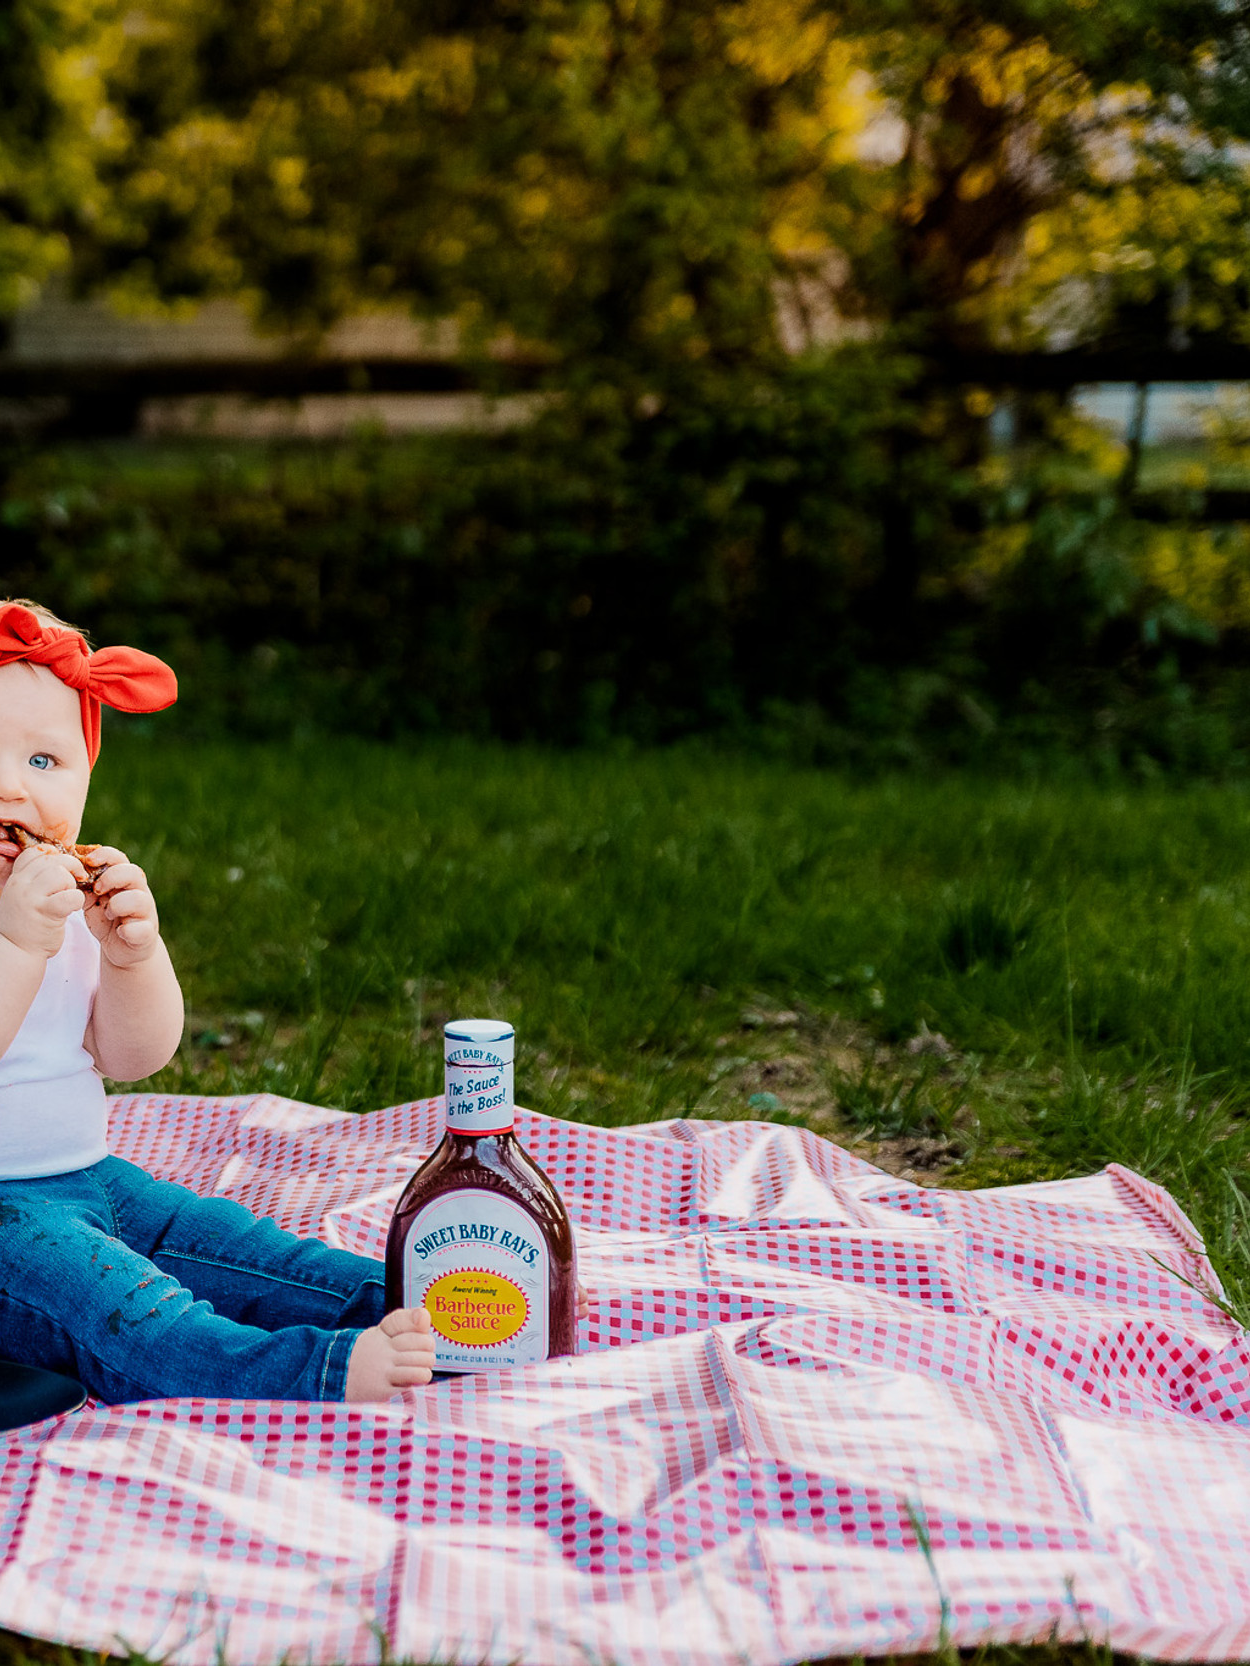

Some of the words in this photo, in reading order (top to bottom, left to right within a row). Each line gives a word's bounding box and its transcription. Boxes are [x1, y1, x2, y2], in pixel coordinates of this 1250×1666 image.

[462, 1048, 485, 1059] BABY
[448, 1082, 464, 1097] The
[466, 1075, 500, 1094] Sauce
[448, 1102, 455, 1116] is
[457, 1100, 474, 1115] the
[477, 1087, 506, 1111] Boss!
[413, 1225, 456, 1260] SWEET
[458, 1223, 499, 1241] BABY
[499, 1229, 540, 1264] RAY'S
[452, 1286, 473, 1294] Award
[435, 1296, 516, 1316] Barbecue
[450, 1315, 501, 1332] Sauce
